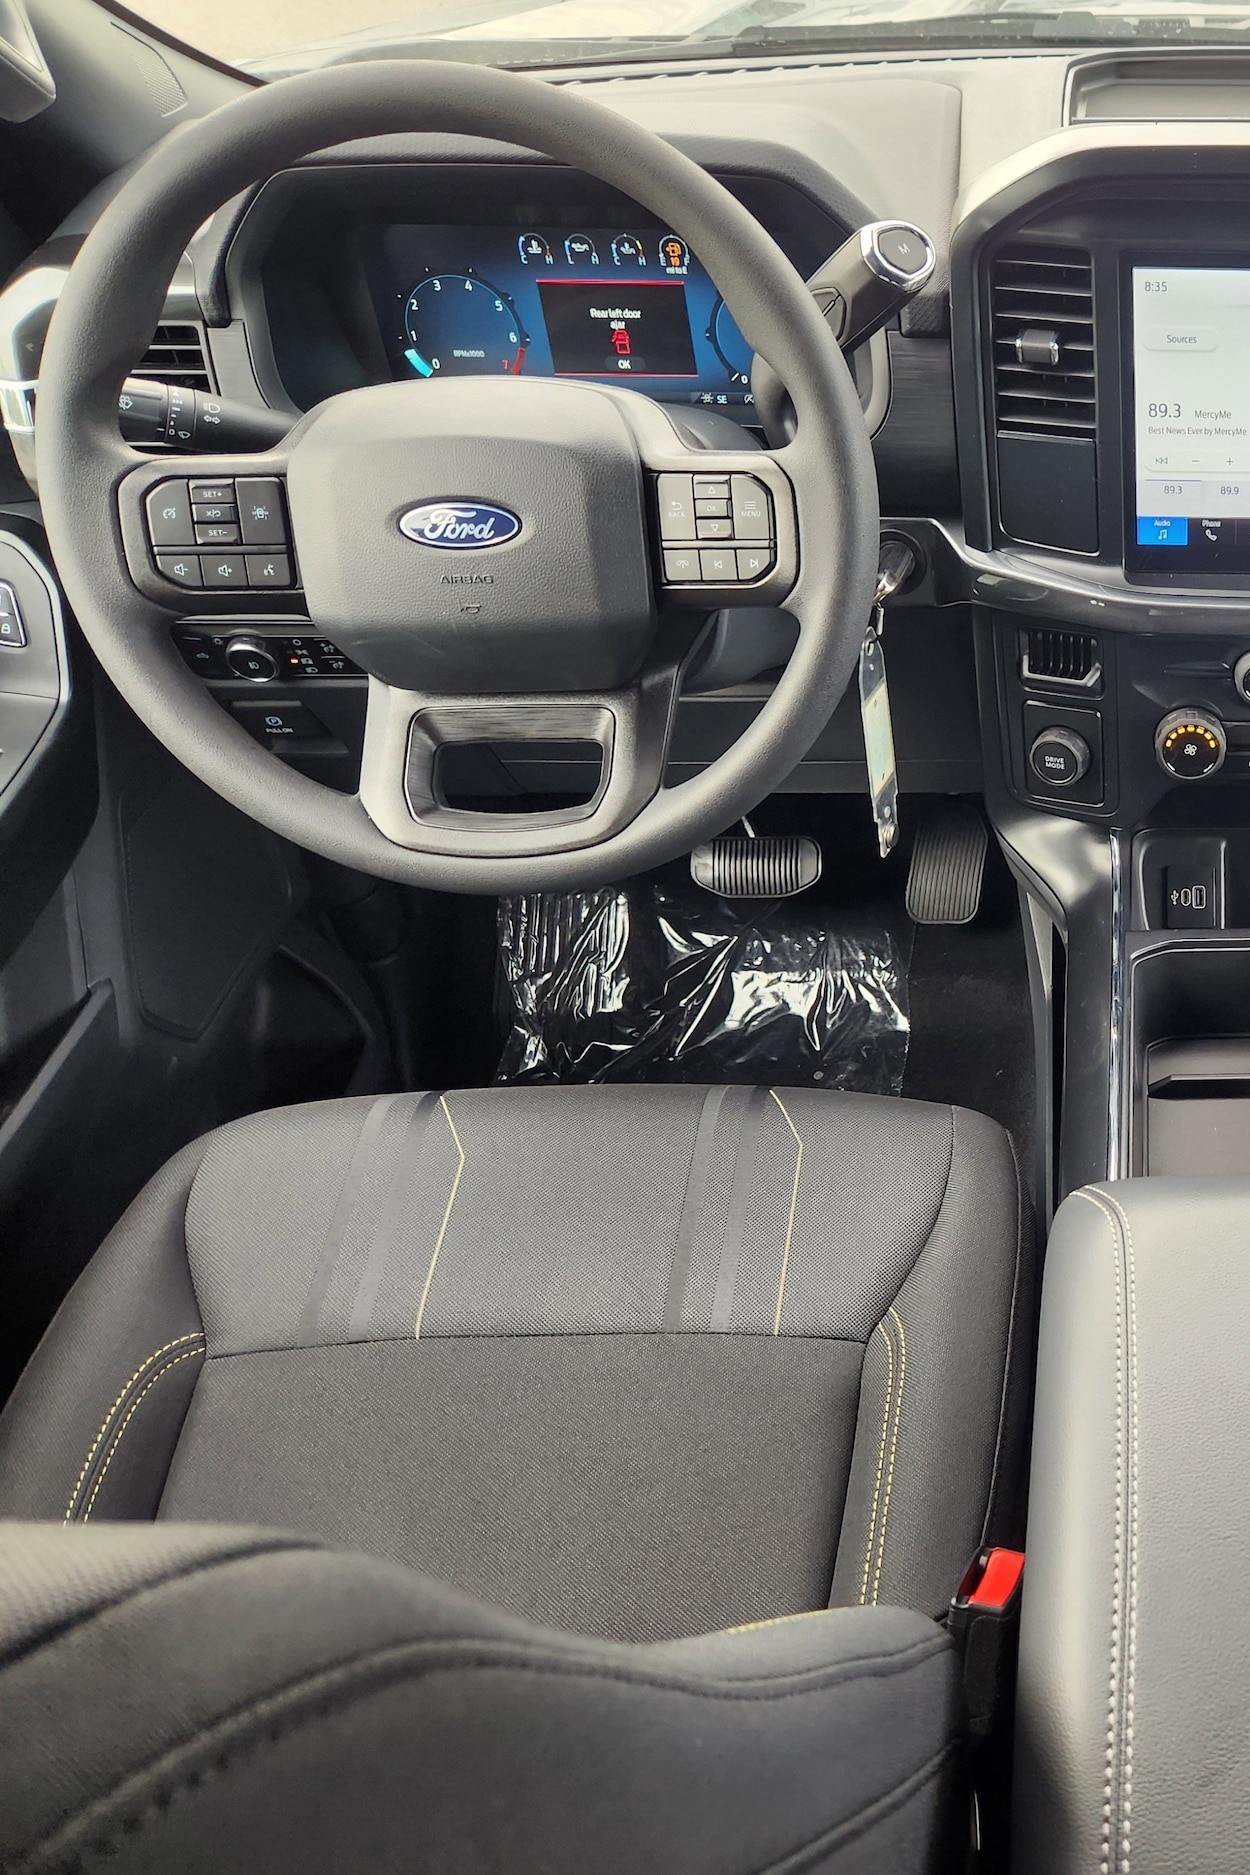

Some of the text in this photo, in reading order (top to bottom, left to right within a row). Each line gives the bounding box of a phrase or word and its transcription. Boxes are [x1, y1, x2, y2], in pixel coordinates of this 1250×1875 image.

[545, 255, 554, 265] H
[638, 256, 646, 266] H
[433, 280, 441, 291] 3
[464, 280, 473, 291] 4
[1144, 281, 1168, 292] 8:35
[411, 299, 419, 310] 2
[495, 300, 503, 311] 5
[590, 308, 641, 319] Rear left door
[610, 319, 626, 330] ajar
[410, 330, 417, 341] 1
[509, 332, 517, 343] 6
[1166, 334, 1198, 344] Sources
[432, 358, 440, 369] 0
[617, 360, 632, 369] OK
[740, 375, 748, 384] 0
[1148, 403, 1232, 419] 89.3 MercyMe
[1148, 426, 1247, 437] Best News Ever by MercyMe
[1164, 485, 1183, 495] 89.3
[1220, 486, 1240, 495] 89.9
[741, 510, 761, 518] MENU
[424, 508, 496, 540] Ford
[1153, 519, 1171, 527] Audio
[1202, 520, 1221, 528] Phone
[440, 574, 494, 585] AIRBAG
[1044, 755, 1065, 764] DRIVE
[1045, 762, 1065, 770] MODE
